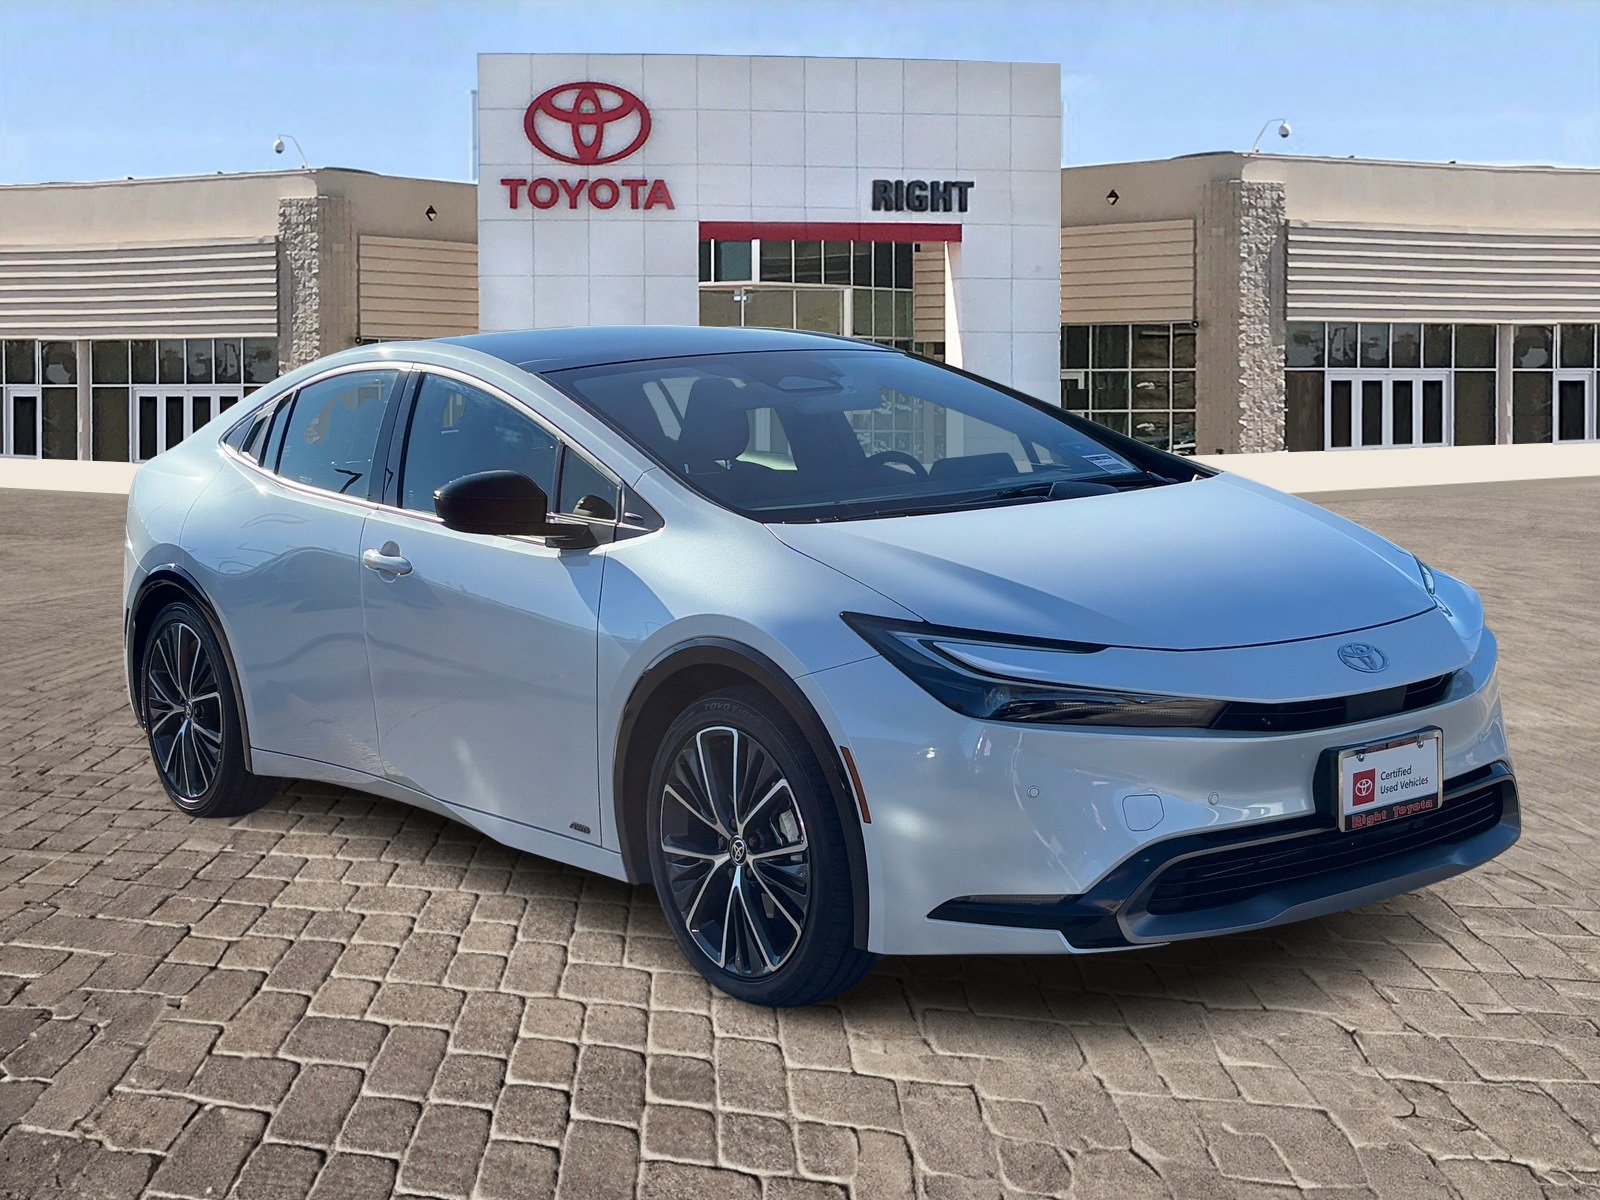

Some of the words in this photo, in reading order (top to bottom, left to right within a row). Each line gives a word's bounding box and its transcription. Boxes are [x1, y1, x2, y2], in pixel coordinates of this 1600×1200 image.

[500, 178, 675, 210] TOYOTA
[871, 179, 975, 212] RIGHT
[704, 702, 731, 711] TOYO
[1380, 765, 1412, 780] Certified
[1380, 782, 1398, 795] Used
[1400, 776, 1429, 790] Vehicles
[1352, 810, 1387, 828] Right
[1393, 800, 1433, 818] Toyota
